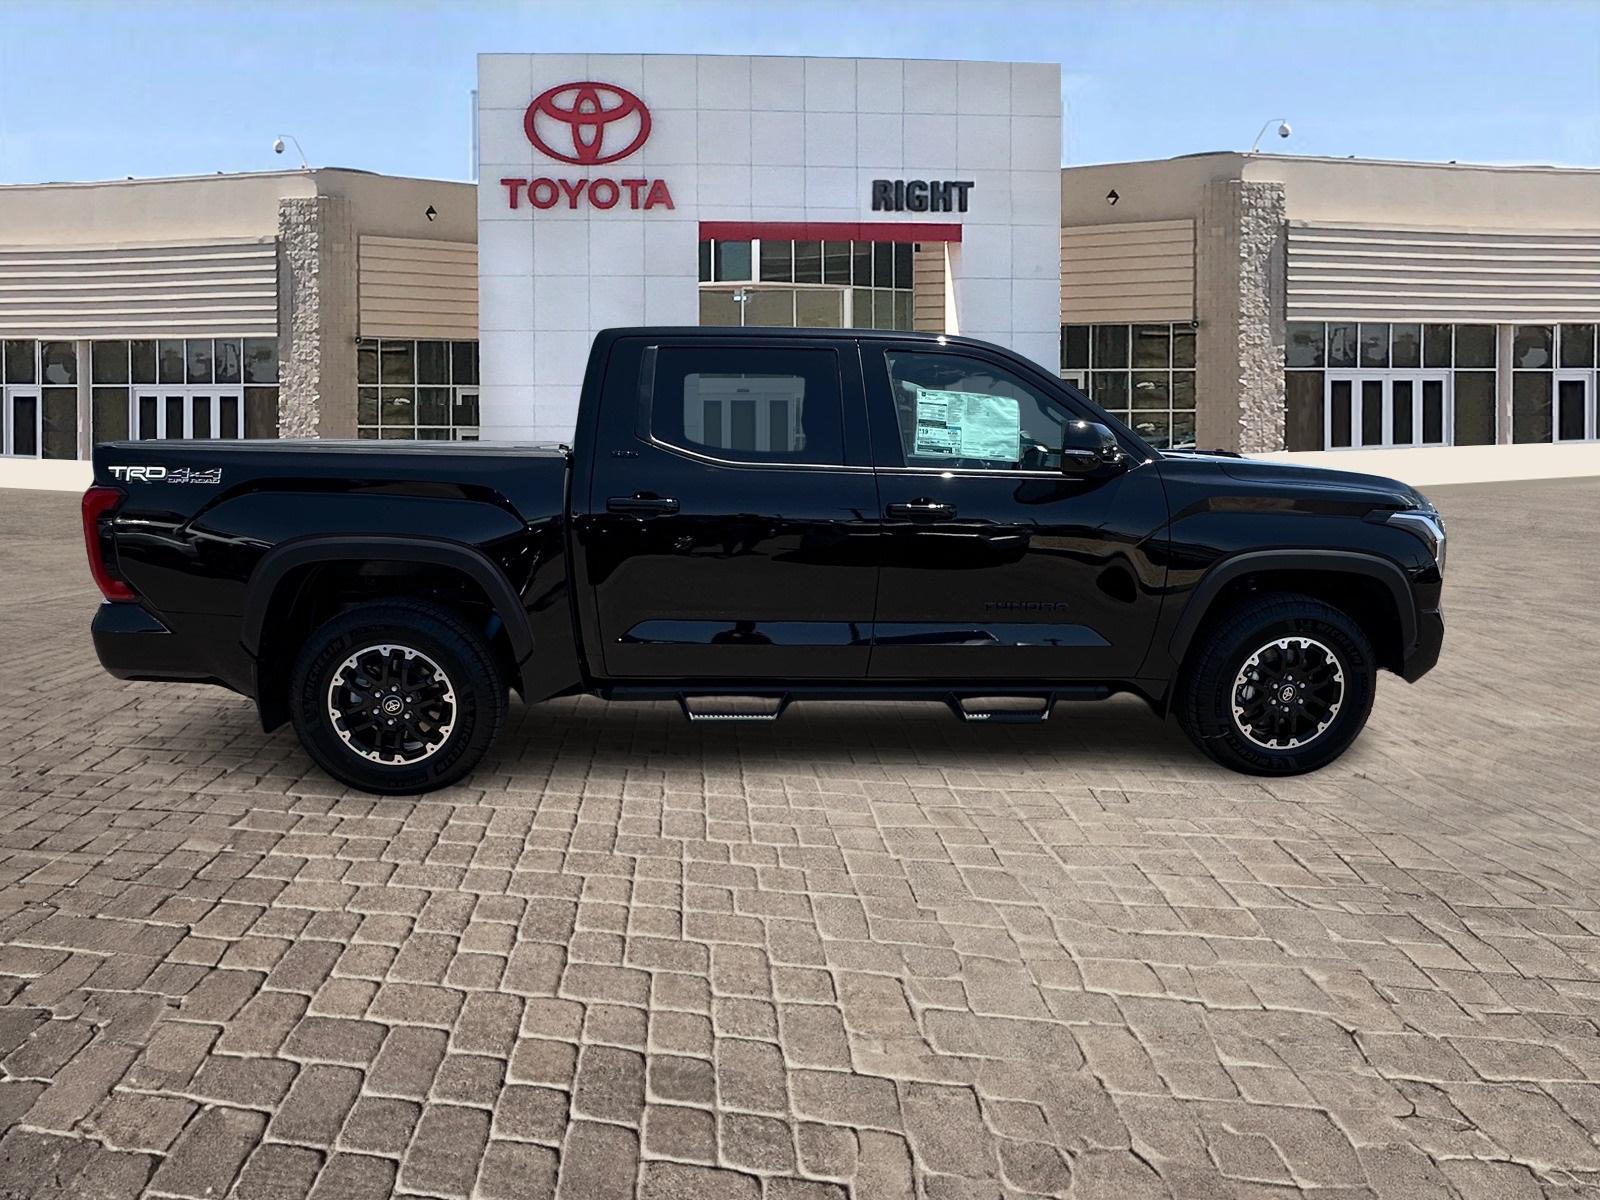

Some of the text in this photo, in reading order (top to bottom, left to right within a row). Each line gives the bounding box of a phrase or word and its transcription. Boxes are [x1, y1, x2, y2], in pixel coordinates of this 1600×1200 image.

[500, 178, 675, 210] TOYOTA
[872, 180, 974, 212] RIGHT
[108, 466, 166, 483] TRD
[983, 600, 1069, 611] TUNDRA
[303, 639, 343, 701] MICHELIN
[434, 716, 476, 775] MICHELIN
